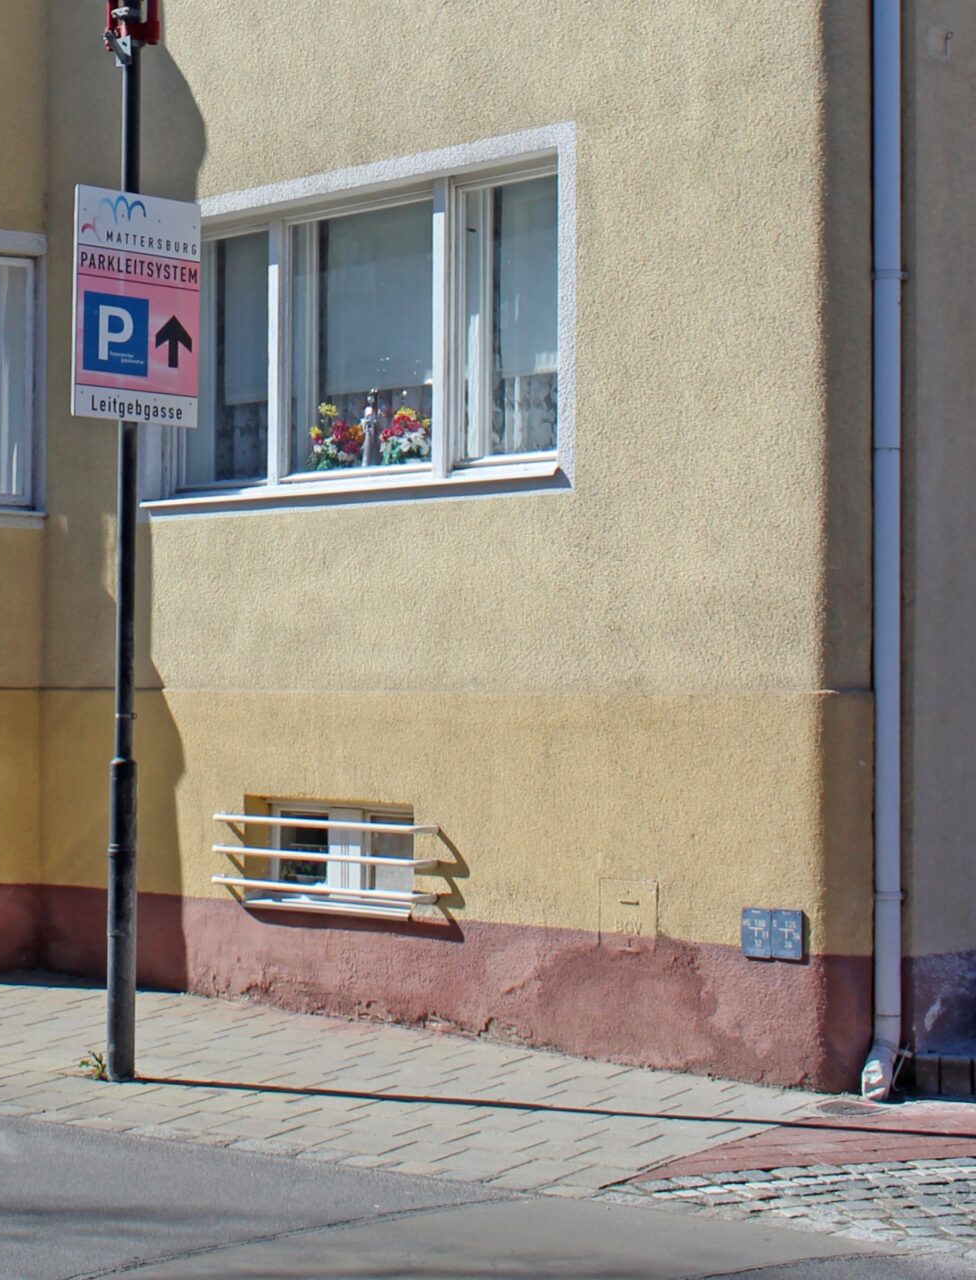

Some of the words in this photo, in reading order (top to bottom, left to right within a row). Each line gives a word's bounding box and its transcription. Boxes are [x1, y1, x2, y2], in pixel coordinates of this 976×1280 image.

[106, 230, 197, 255] MATTERSBURG
[80, 251, 198, 284] PARKLEITSYSTEM
[98, 304, 134, 360] P
[91, 395, 183, 421] Leitgebgasse
